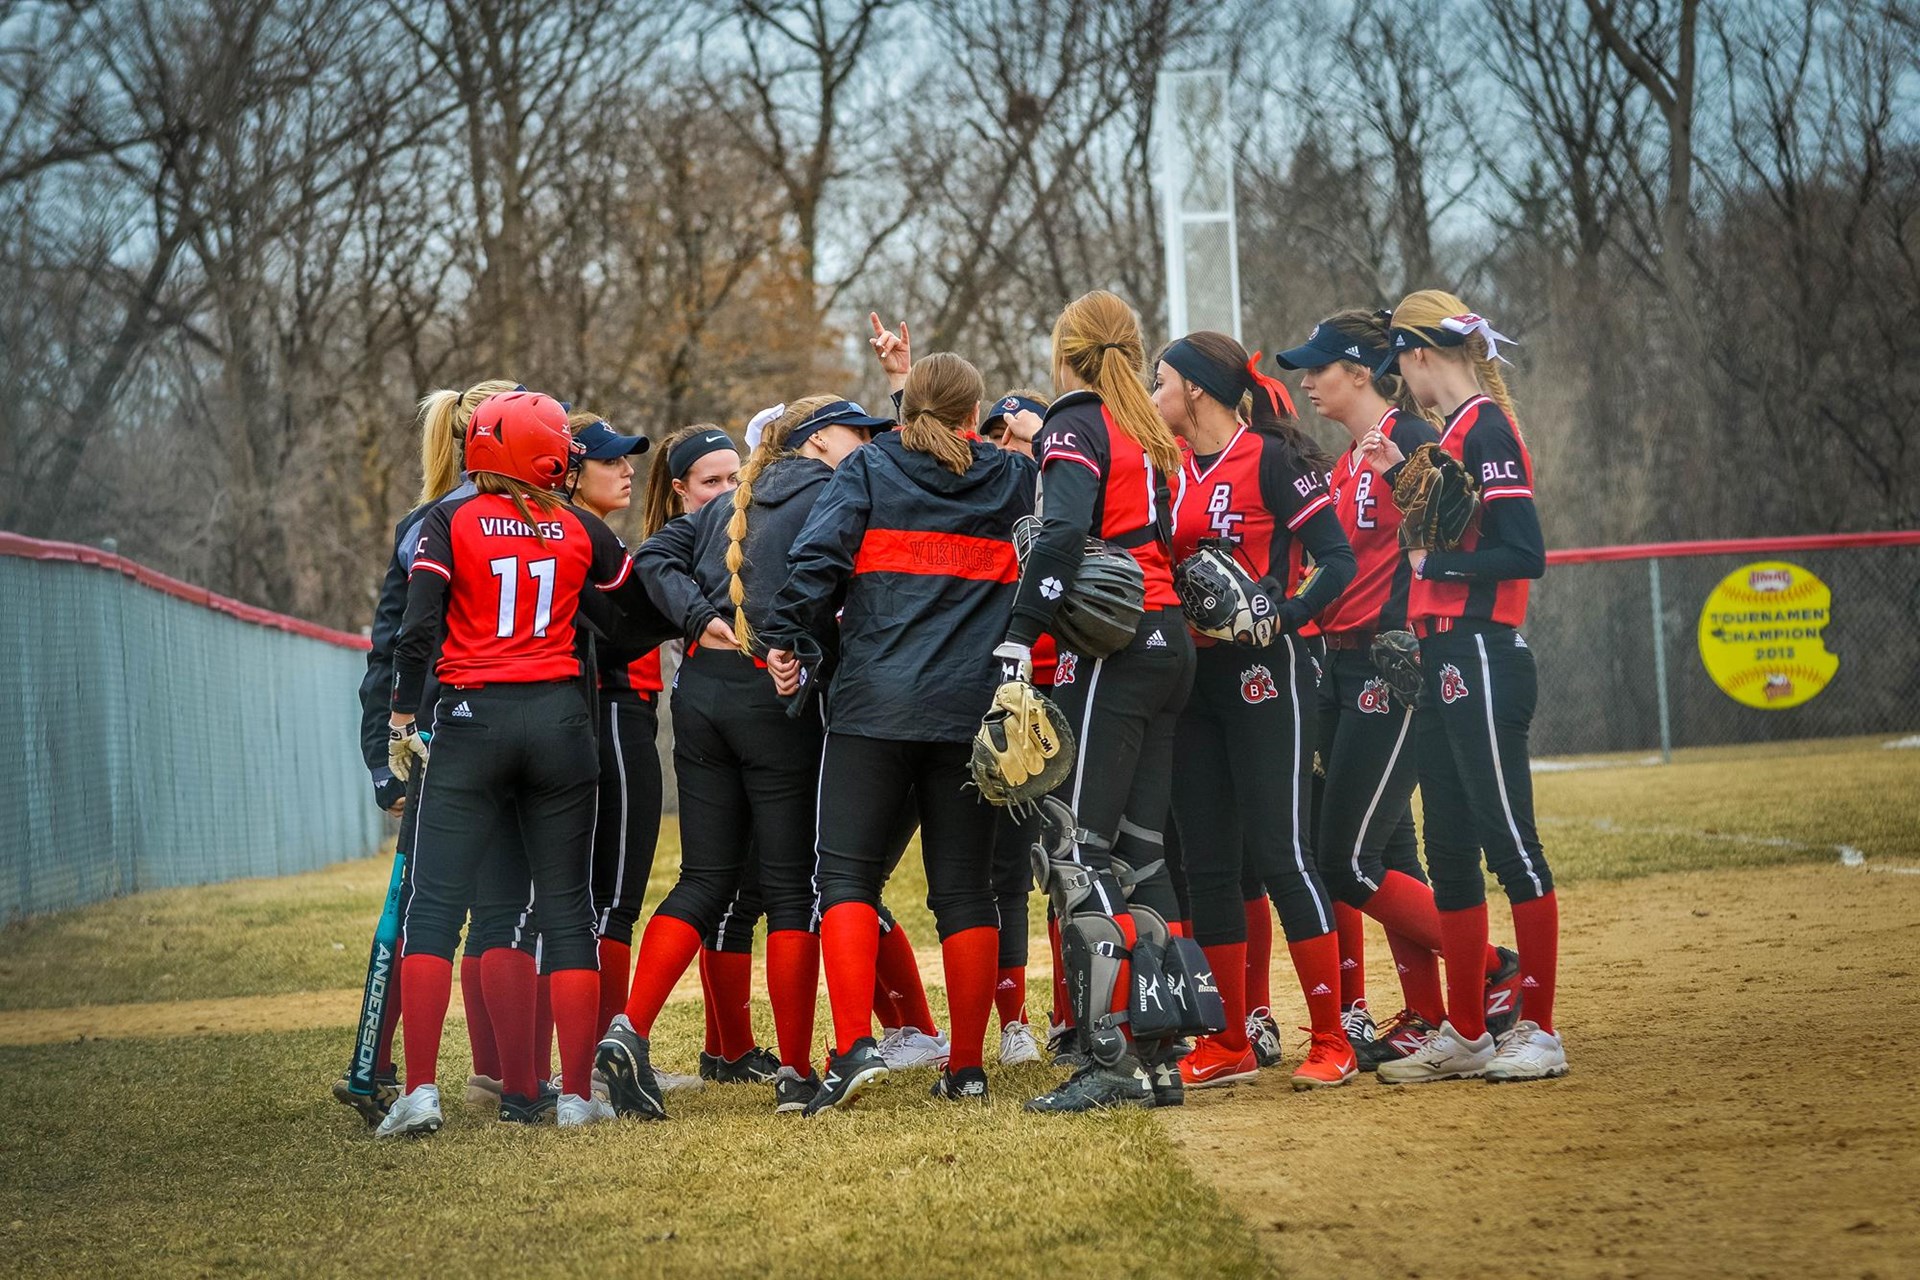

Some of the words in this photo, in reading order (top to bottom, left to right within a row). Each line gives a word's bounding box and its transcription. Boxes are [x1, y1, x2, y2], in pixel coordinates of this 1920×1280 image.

[1482, 461, 1518, 483] BLC
[479, 516, 565, 540] VIKINGS
[909, 541, 994, 571] VIKINGS
[489, 556, 556, 637] 11
[1711, 608, 1829, 624] TOURNAMEN
[451, 710, 473, 718] adidas
[356, 942, 391, 1081] ANDERSON
